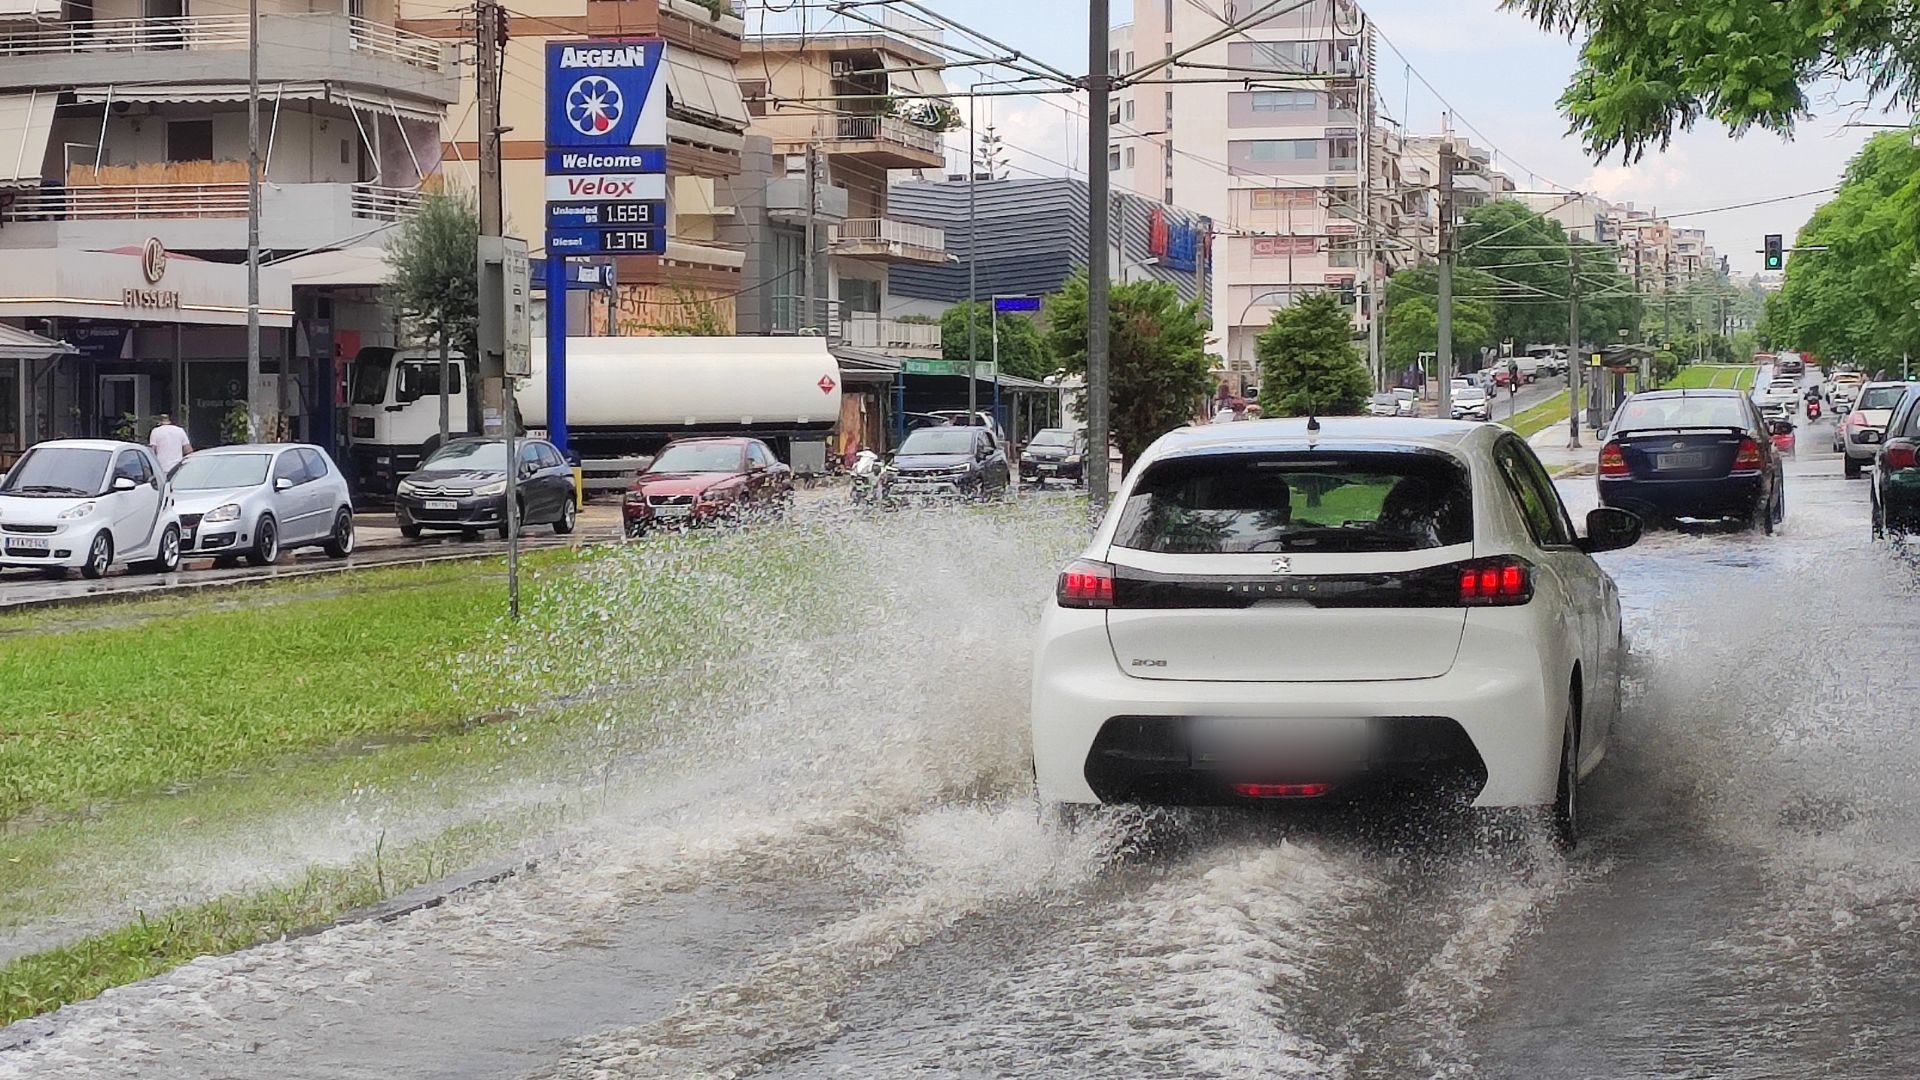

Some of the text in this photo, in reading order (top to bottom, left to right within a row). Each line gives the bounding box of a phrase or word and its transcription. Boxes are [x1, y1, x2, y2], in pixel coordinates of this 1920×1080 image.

[560, 46, 644, 68] AEGEAN
[562, 154, 642, 168] Welcome
[568, 177, 635, 197] Velox
[552, 204, 649, 222] Unleaded 1.659
[552, 232, 647, 249] Diesel 1.379
[1132, 658, 1167, 667] 208
